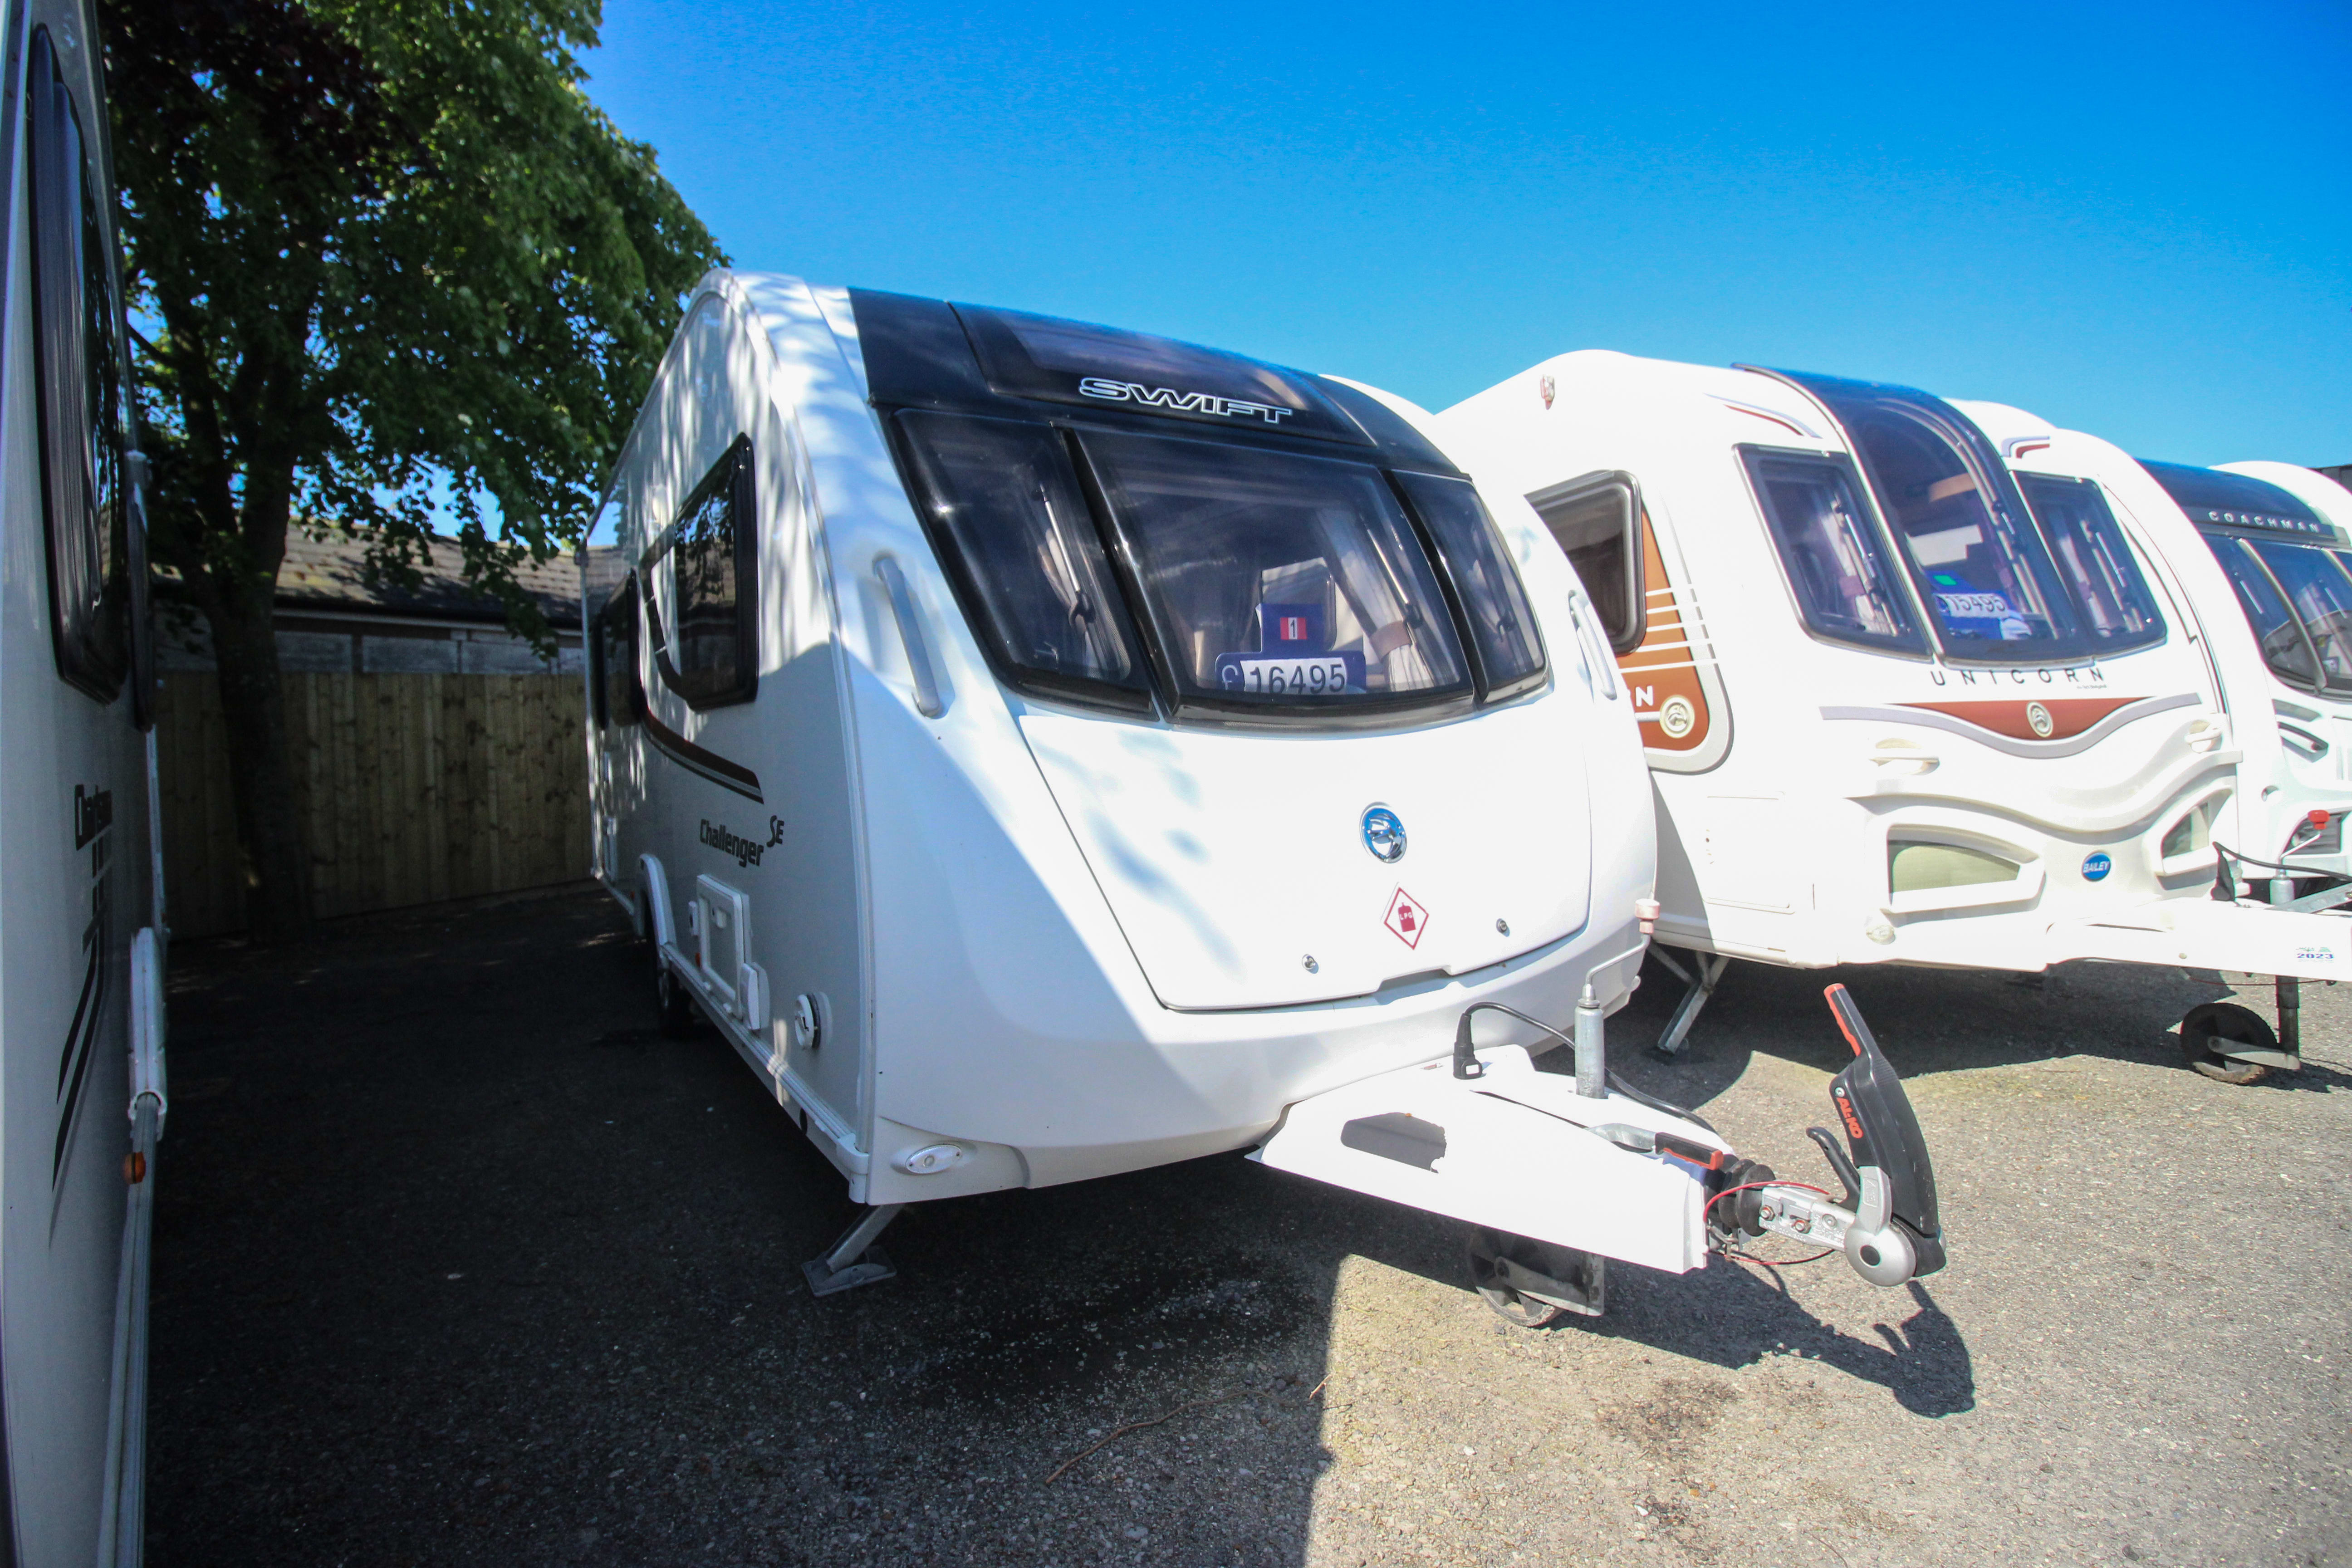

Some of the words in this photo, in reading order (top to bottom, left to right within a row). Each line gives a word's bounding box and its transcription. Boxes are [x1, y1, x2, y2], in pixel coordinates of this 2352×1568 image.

[1079, 377, 1292, 424] SWIFT
[2208, 510, 2320, 533] COACHMAN
[1289, 620, 1296, 638] 1
[1931, 667, 2104, 686] UNICORN
[700, 818, 764, 867] Challenger
[766, 815, 784, 848] SE
[2083, 861, 2109, 873] BAILEY
[1399, 912, 1412, 920] LPG
[1836, 1097, 1864, 1139] AL-KO
